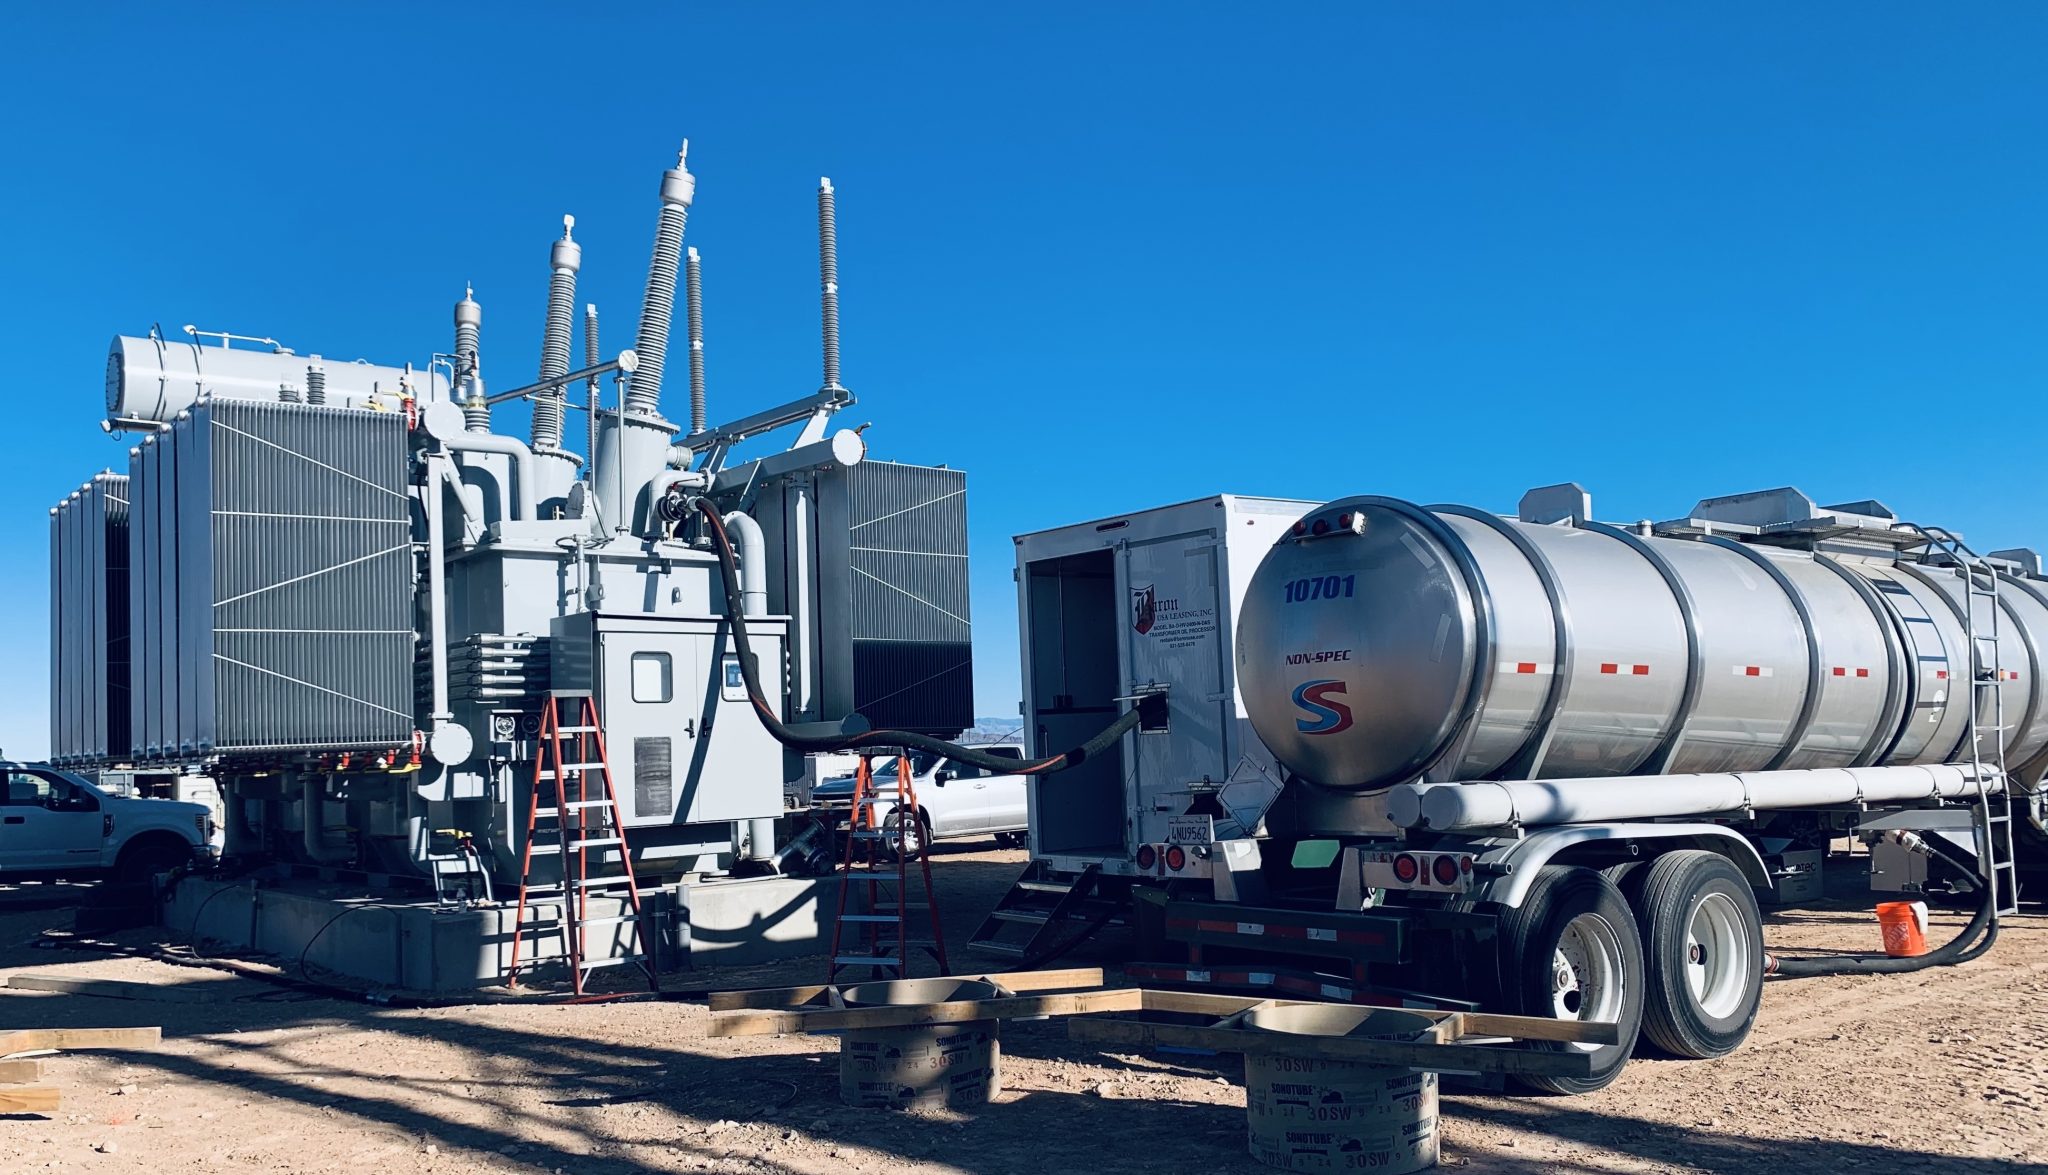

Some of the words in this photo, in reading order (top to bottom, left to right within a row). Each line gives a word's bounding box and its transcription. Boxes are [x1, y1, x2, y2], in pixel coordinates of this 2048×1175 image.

[1284, 574, 1355, 604] 10701
[1149, 629, 1180, 638] TRANSFORMER
[1189, 625, 1216, 634] PROCESSOR
[1286, 649, 1352, 666] NON-SPEC
[1171, 826, 1208, 841] 4NU9562
[929, 1055, 964, 1069] 30SW
[1275, 1058, 1314, 1073] 30SW
[1271, 1082, 1314, 1096] SONOTUBE
[1307, 1106, 1351, 1121] 30SW
[1403, 1092, 1430, 1113] 30SW
[1285, 1132, 1333, 1145] SONOTUBE
[1345, 1151, 1389, 1169] 30SW
